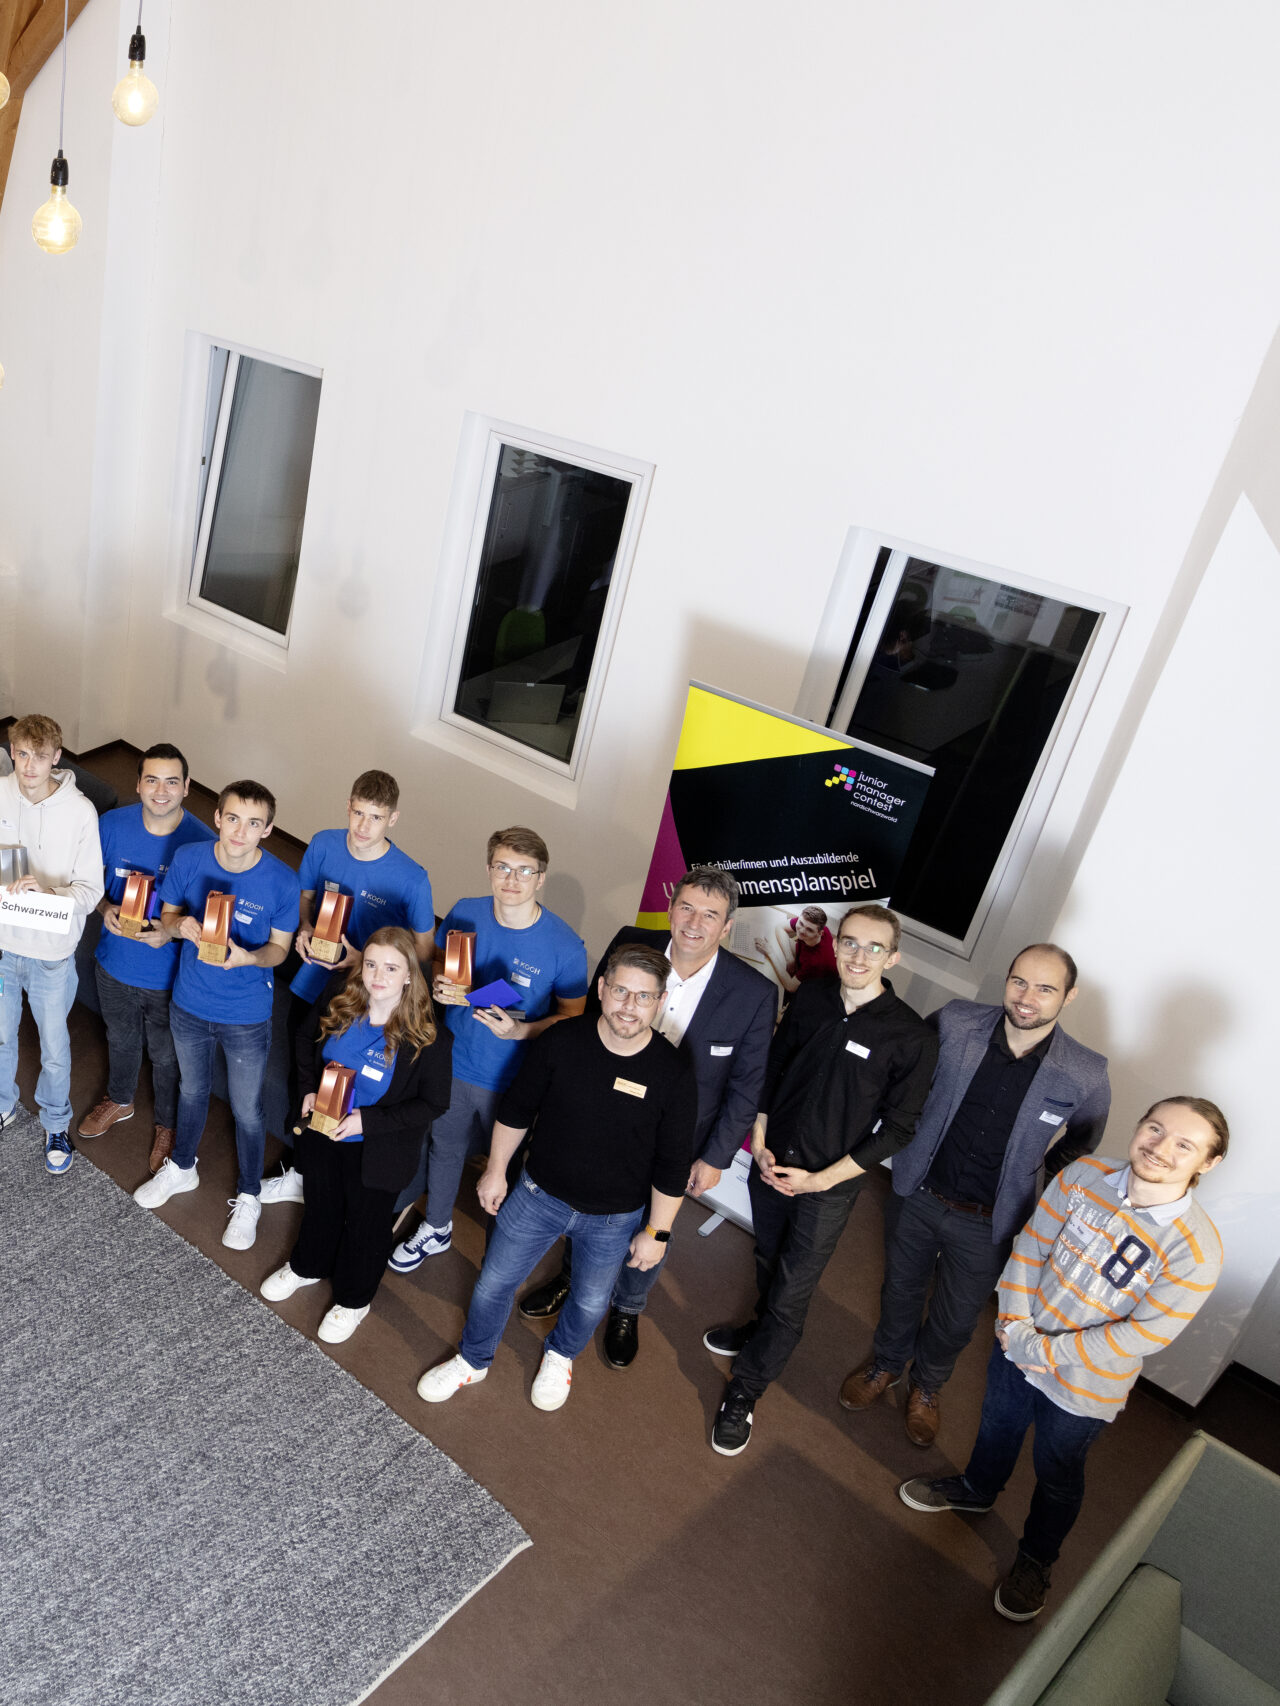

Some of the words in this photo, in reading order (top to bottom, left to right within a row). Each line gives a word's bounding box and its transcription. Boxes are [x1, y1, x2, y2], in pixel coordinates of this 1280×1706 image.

[857, 771, 888, 789] junior
[853, 792, 893, 812] contest
[856, 782, 907, 806] manager
[850, 801, 898, 823] nordschwarzwald
[769, 856, 788, 868] und
[790, 852, 860, 866] Auszubildende
[1, 901, 69, 920] Schwarzwald
[520, 961, 541, 975] KOCH
[1101, 1235, 1151, 1289] 8
